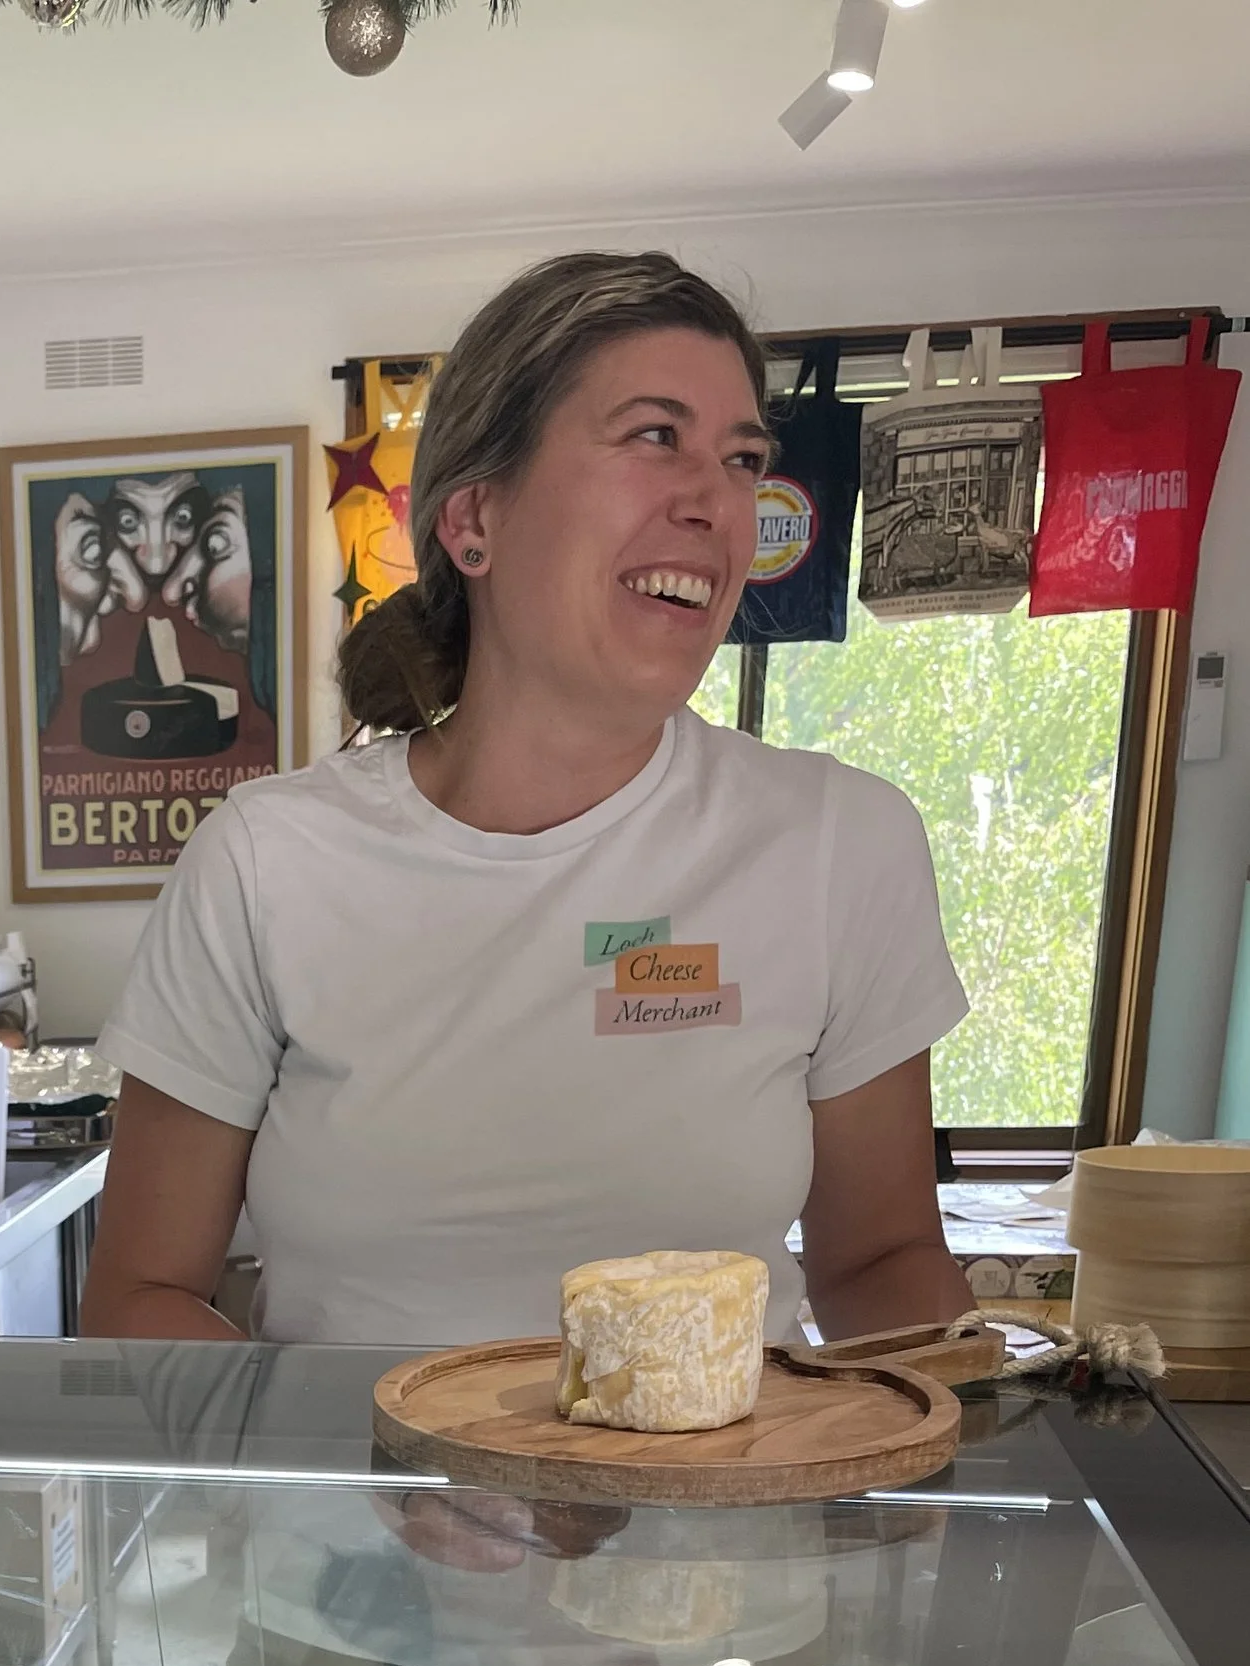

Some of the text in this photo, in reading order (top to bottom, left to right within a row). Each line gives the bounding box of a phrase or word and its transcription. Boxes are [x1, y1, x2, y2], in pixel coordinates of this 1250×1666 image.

[757, 514, 811, 543] AVERO
[42, 769, 165, 796] PARMIGIANO
[630, 953, 703, 981] Cheese
[613, 998, 722, 1024] Merchant
